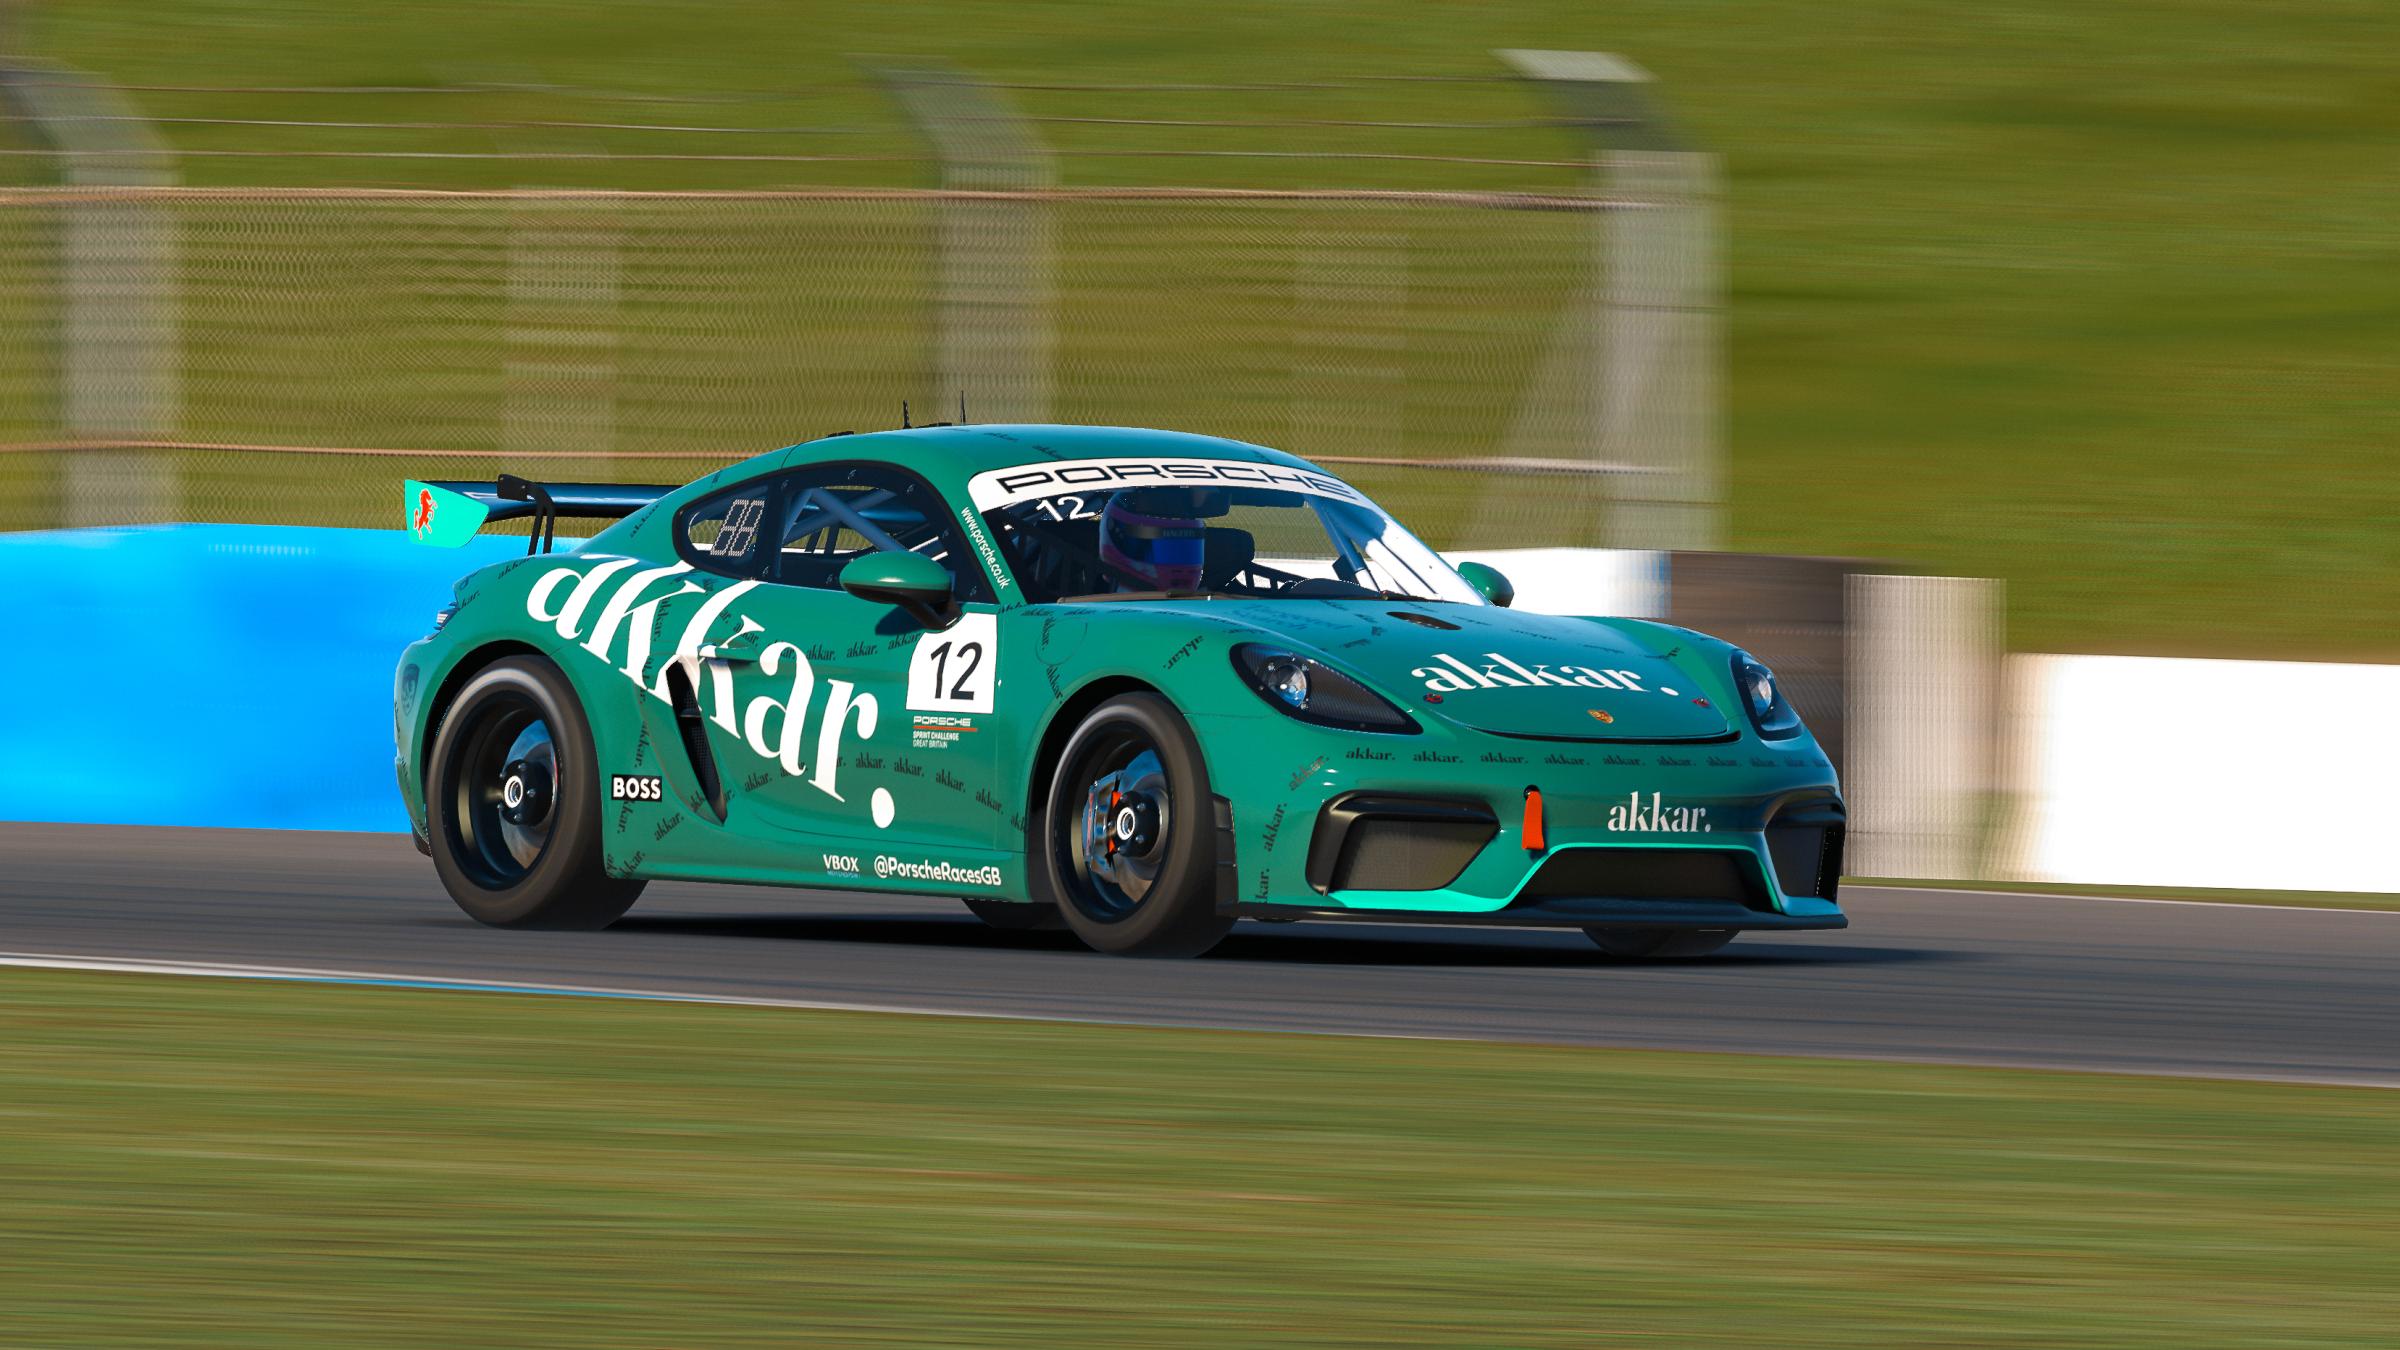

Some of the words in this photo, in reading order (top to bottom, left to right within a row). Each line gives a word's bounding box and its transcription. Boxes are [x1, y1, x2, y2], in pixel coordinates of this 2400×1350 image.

[996, 464, 1357, 500] PORSCHE
[1036, 496, 1097, 522] 12
[961, 507, 1010, 589] www.porsche.co.uk
[930, 641, 983, 701] 12
[1411, 652, 1680, 697] akkar.
[913, 716, 972, 727] PORSCHE
[856, 752, 886, 769] akkar.
[894, 754, 925, 777] akkar.
[936, 768, 966, 793] akkar.
[1289, 755, 1330, 791] akkar.
[1345, 747, 1396, 761] akkar.
[1412, 751, 1464, 764] akkar.
[1480, 752, 1529, 765] akkar.
[1544, 752, 1591, 766] akkar.
[612, 777, 661, 800] BOSS
[1263, 802, 1288, 852] akkar.
[1608, 790, 1712, 833] akkar.
[823, 854, 860, 872] VBOX
[874, 855, 1002, 886] @PorscheRacesGB
